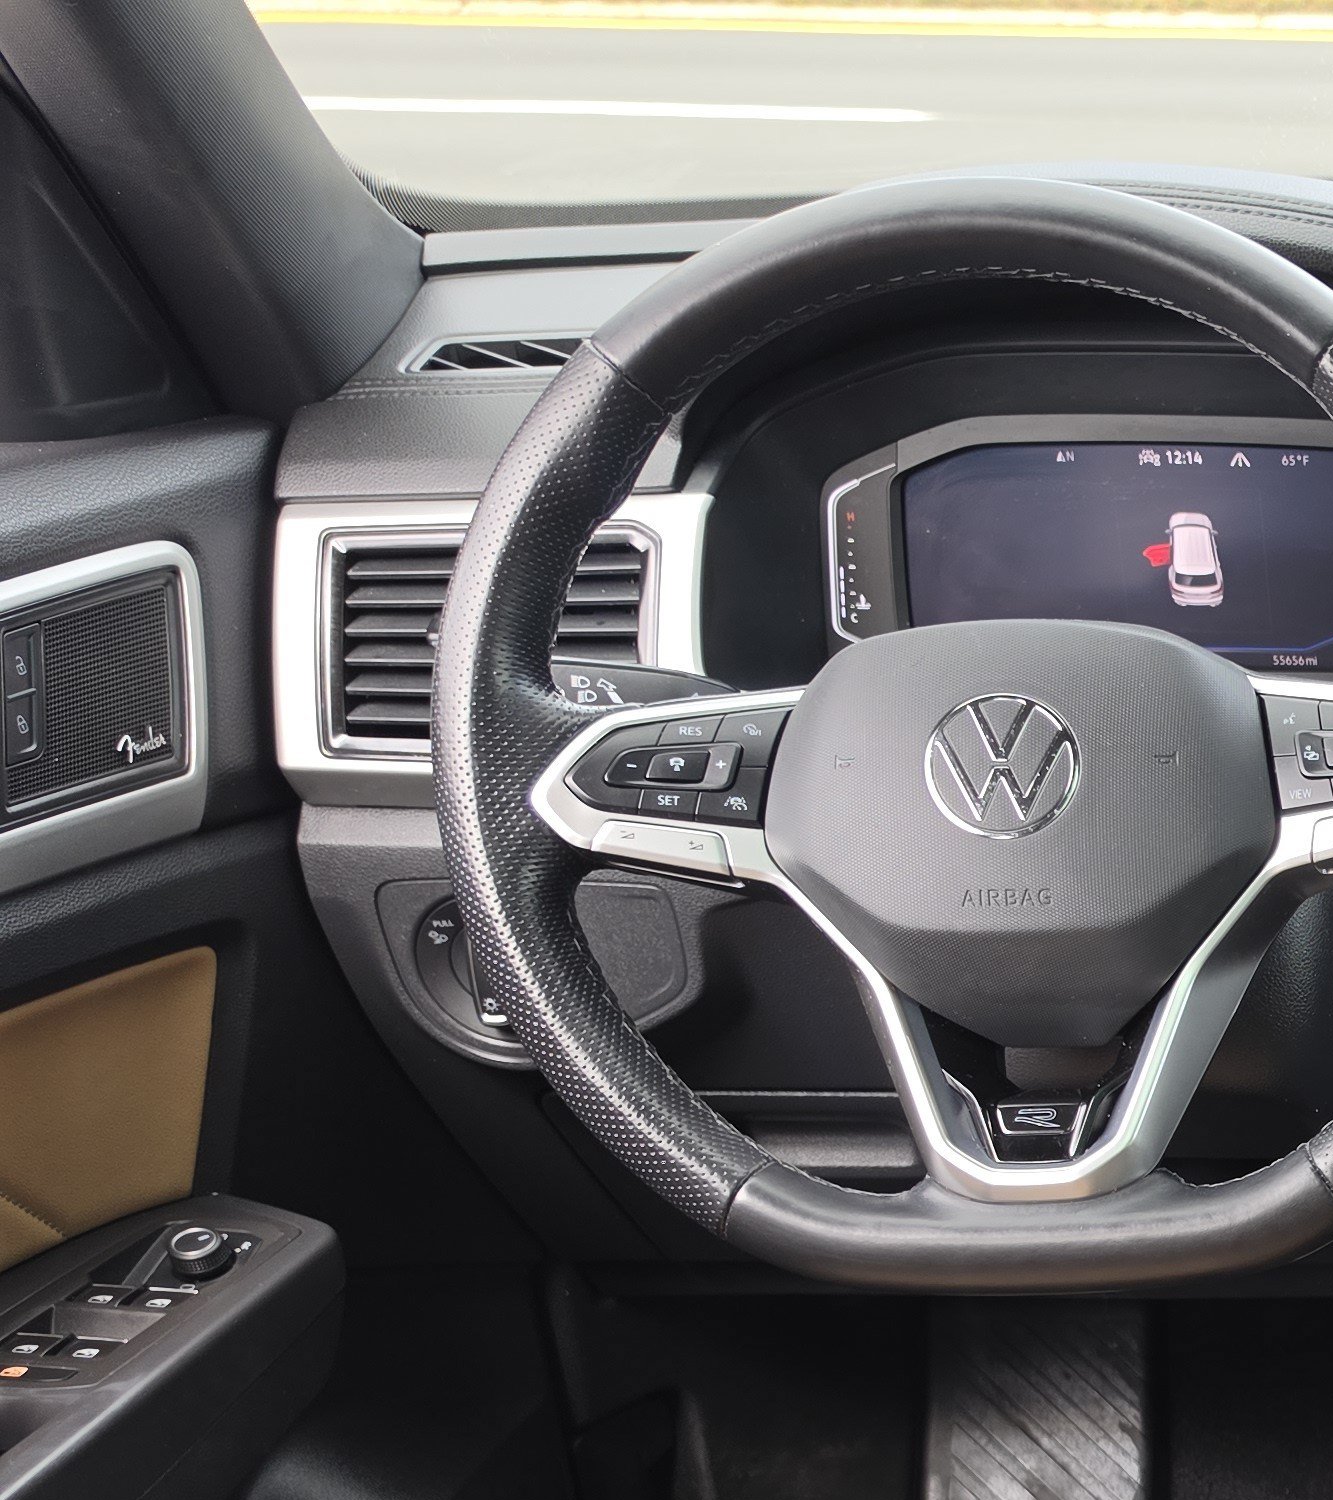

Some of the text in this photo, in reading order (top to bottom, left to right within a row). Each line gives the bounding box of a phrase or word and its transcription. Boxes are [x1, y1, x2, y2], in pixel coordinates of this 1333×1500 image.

[1165, 450, 1203, 465] 12:14
[1281, 454, 1310, 467] 65°F
[679, 726, 703, 737] RES
[116, 726, 167, 764] Fender
[1288, 787, 1312, 800] VIEW
[657, 795, 681, 806] SET
[961, 888, 1053, 908] AIRBAG
